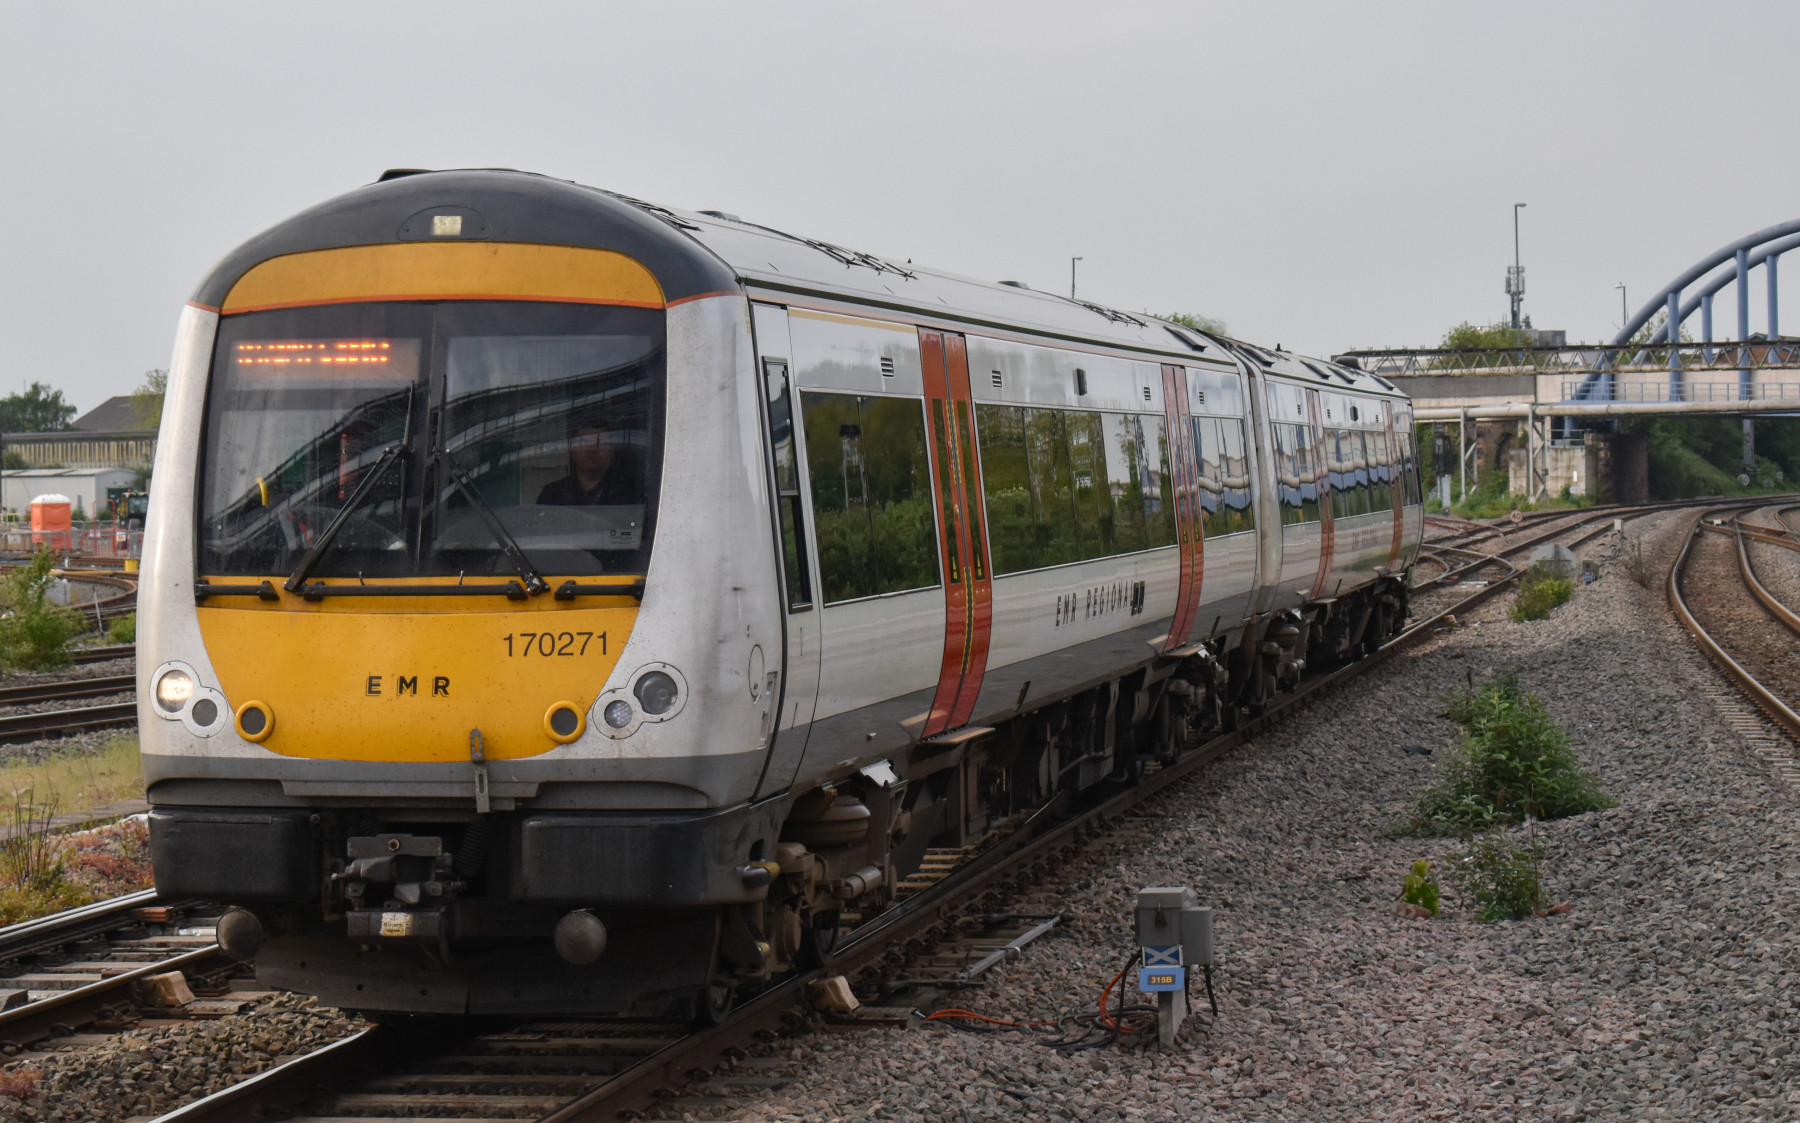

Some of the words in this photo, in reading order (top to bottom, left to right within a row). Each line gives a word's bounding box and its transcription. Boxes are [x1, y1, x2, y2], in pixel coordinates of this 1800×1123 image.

[1055, 592, 1077, 628] EMR
[503, 631, 607, 657] 170271
[366, 675, 451, 697] EMR
[1151, 976, 1173, 984] 315B
